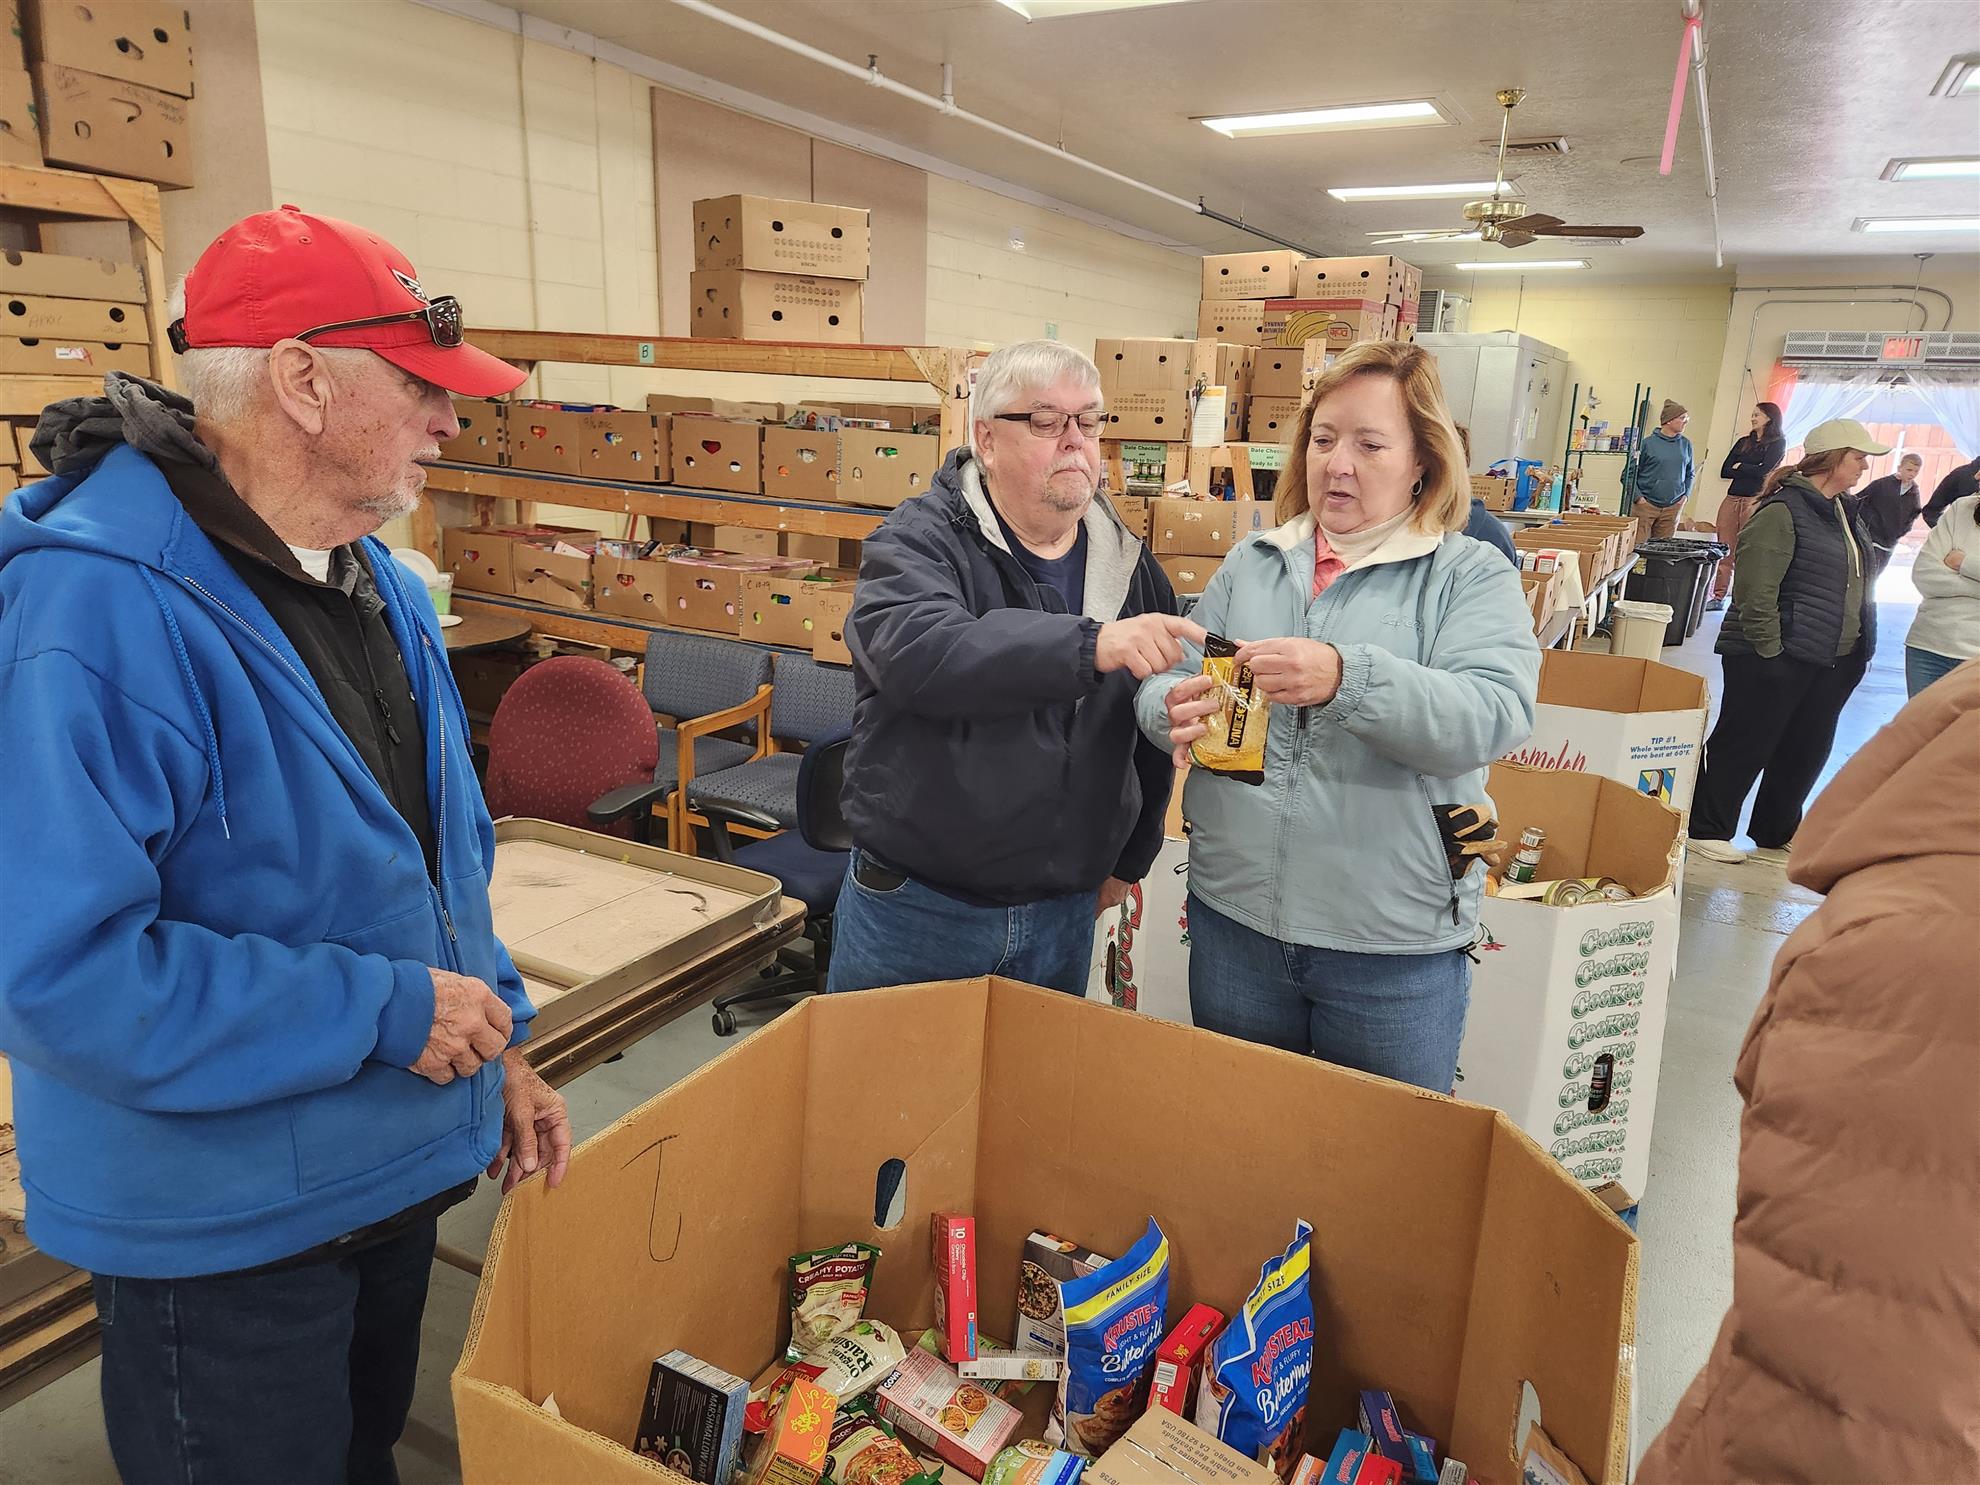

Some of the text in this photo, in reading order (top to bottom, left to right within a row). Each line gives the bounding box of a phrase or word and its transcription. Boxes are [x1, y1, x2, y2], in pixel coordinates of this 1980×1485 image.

[1653, 743, 1694, 752] watermelons
[955, 1227, 966, 1239] 10
[798, 1262, 865, 1284] CREAMY POTATO
[1106, 1266, 1152, 1300] FAMILY SIZE
[1267, 1275, 1285, 1291] SIZE
[828, 1348, 860, 1378] Organic
[829, 1336, 874, 1373] Raisins
[1161, 1419, 1251, 1478] San Diego, CA 92186 USA
[1162, 1429, 1238, 1479] Bumble Bee Seafoods
[776, 1456, 815, 1479] Nutrition Facts
